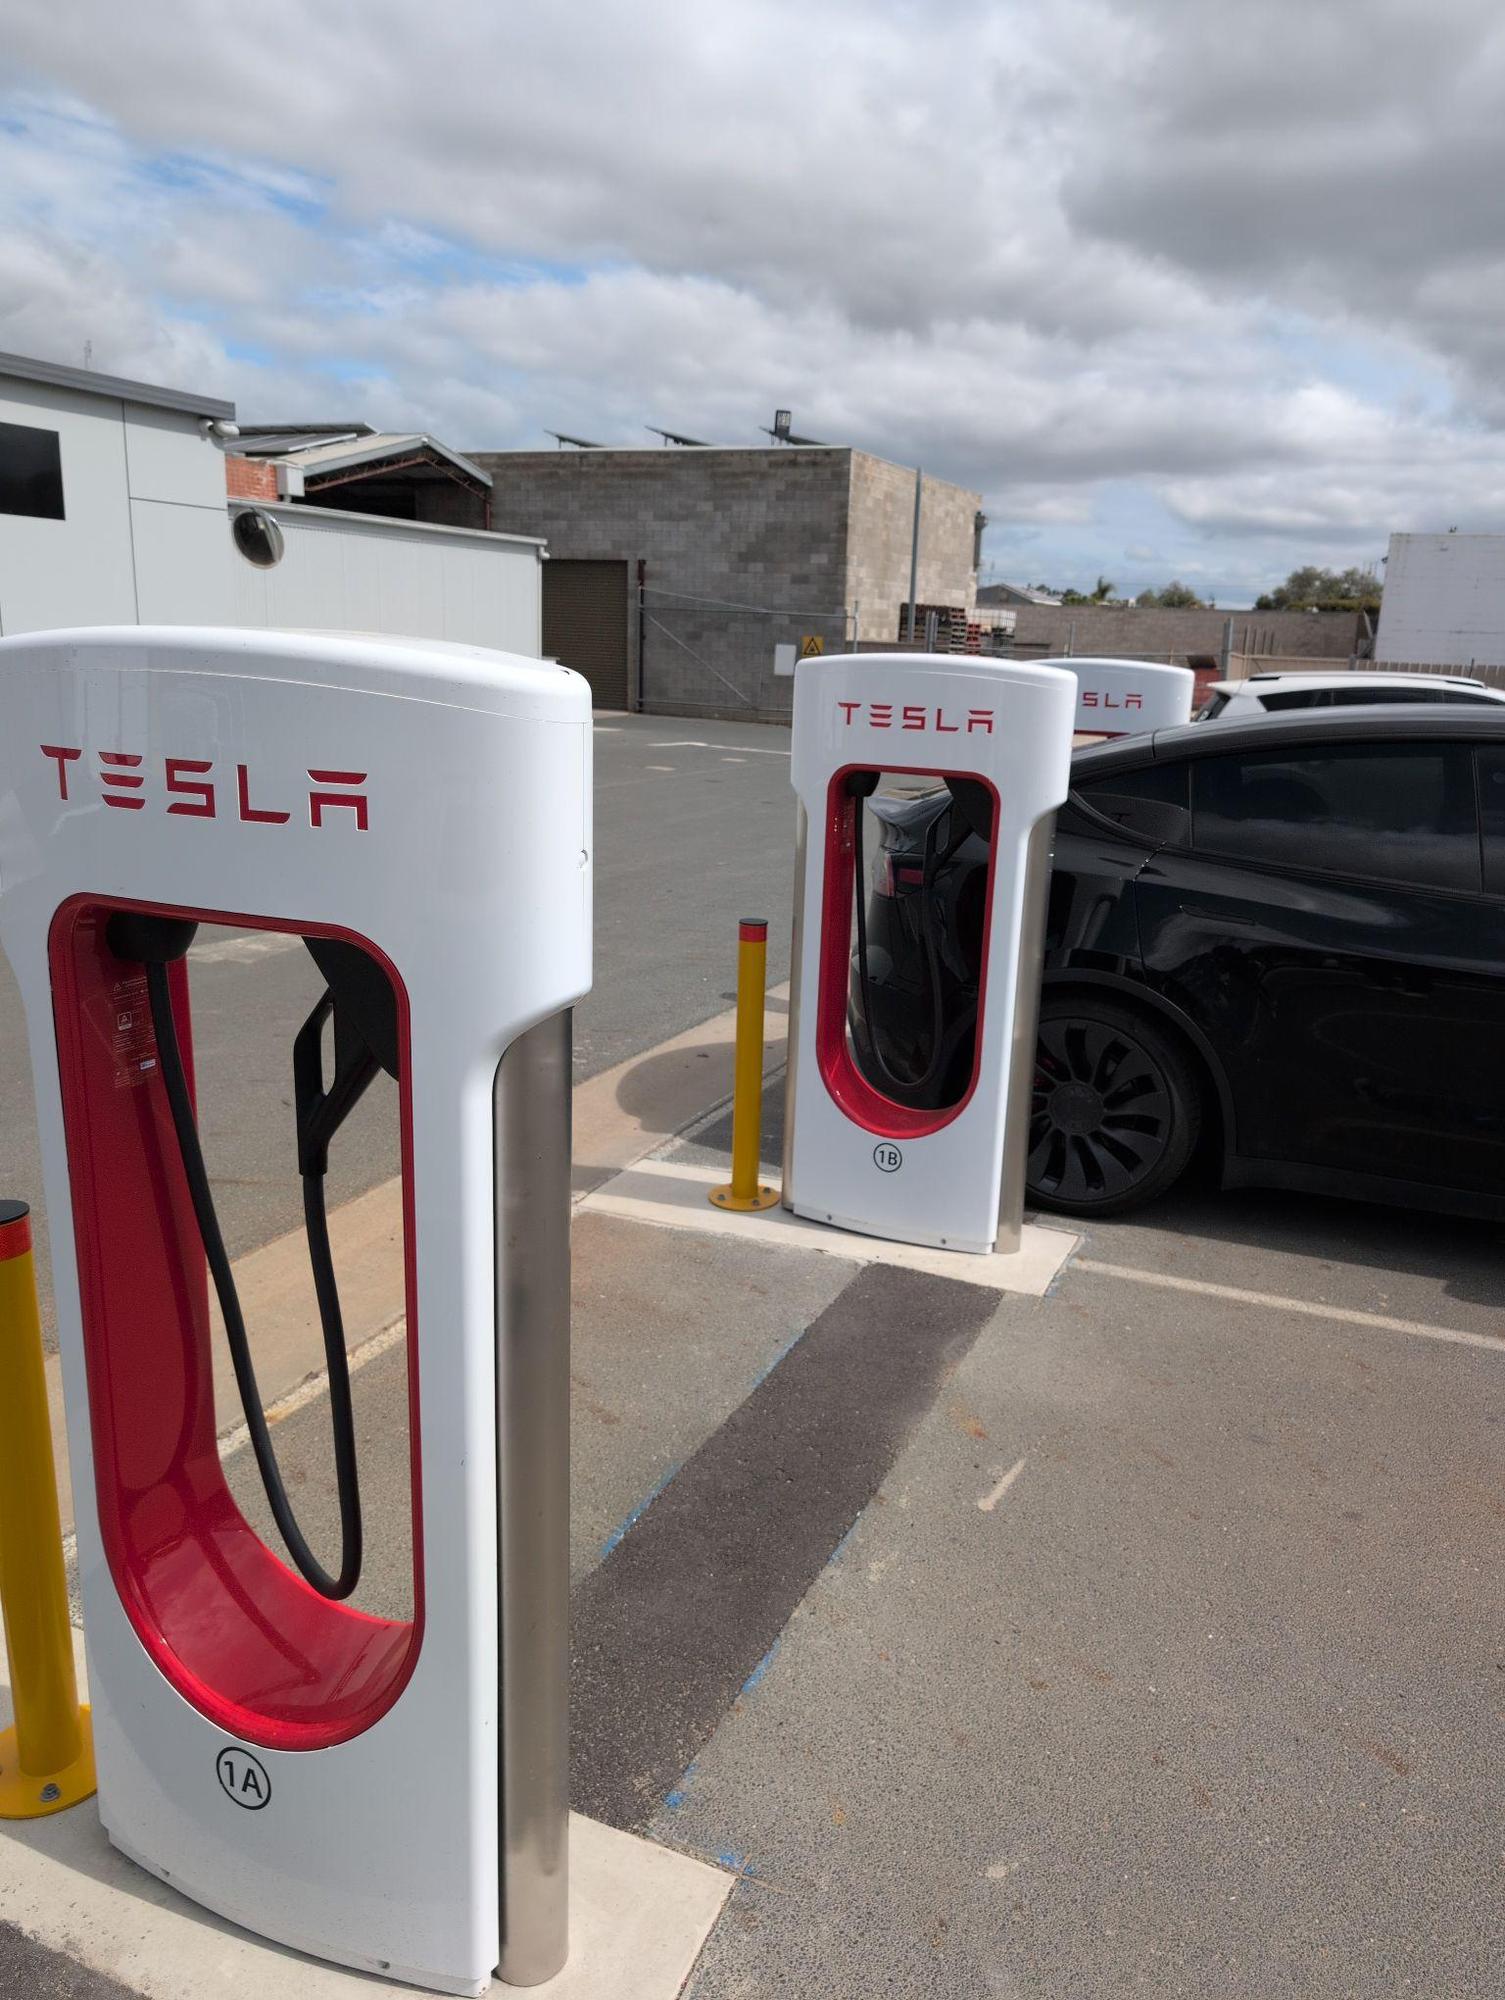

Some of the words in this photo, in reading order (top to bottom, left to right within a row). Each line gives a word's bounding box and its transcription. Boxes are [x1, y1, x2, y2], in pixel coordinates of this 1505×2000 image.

[1082, 692, 1142, 709] SLA
[838, 702, 994, 734] TESLA
[40, 745, 369, 831] TESLA
[879, 1150, 898, 1166] 1B
[224, 1761, 263, 1799] 1A
